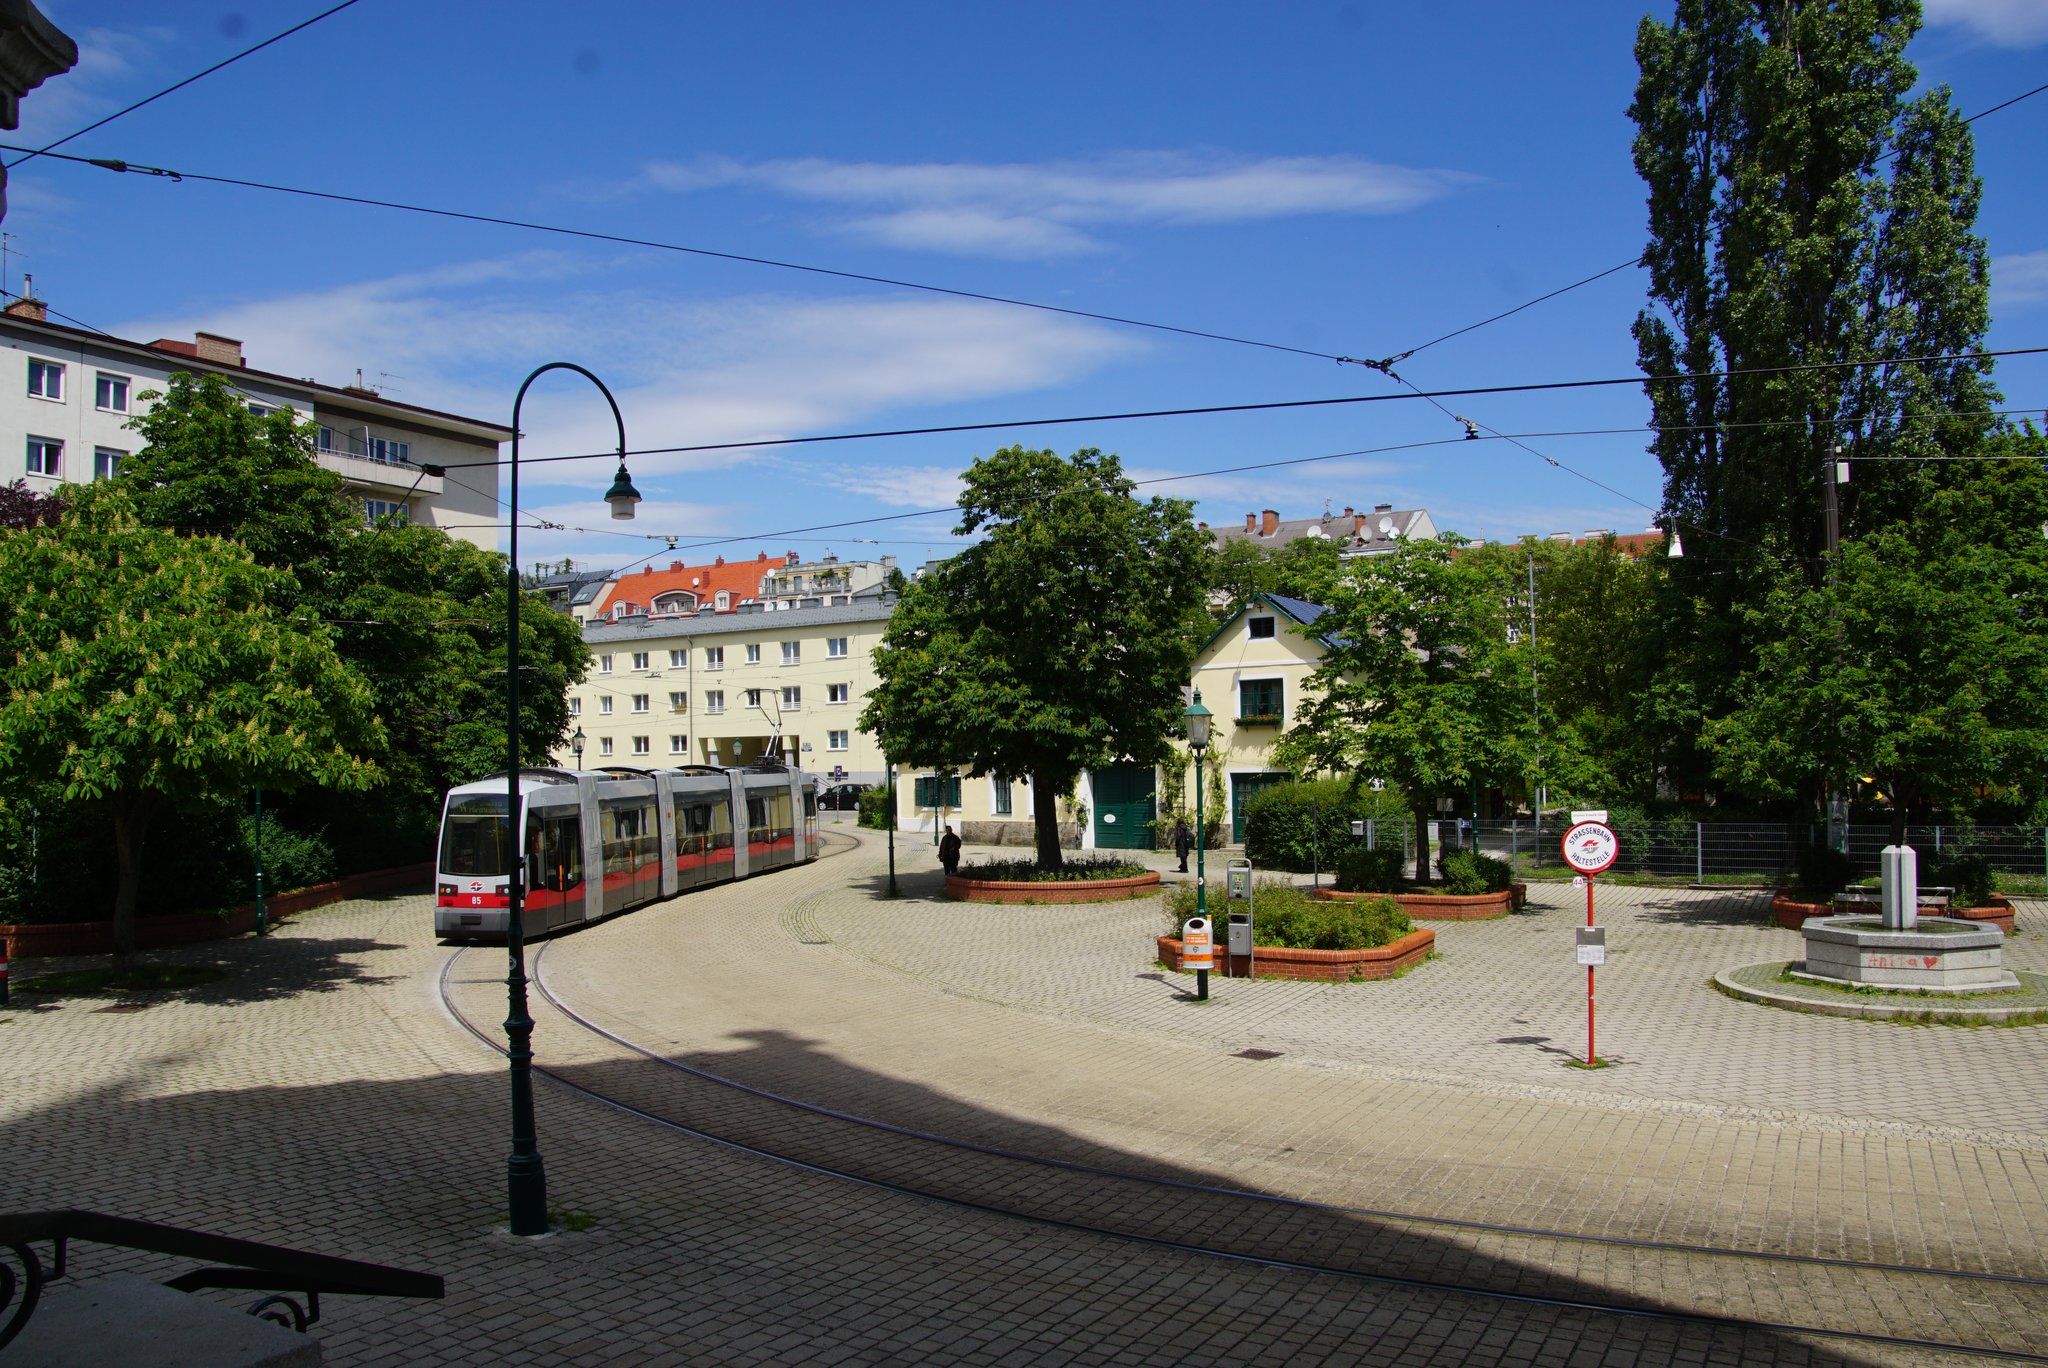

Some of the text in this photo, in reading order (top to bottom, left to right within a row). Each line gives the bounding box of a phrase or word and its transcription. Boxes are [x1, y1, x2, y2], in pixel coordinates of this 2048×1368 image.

[1569, 827, 1611, 845] STRASSENBAHN
[1571, 851, 1610, 866] HALTESTELLE
[471, 896, 482, 905] 85
[1868, 950, 1918, 968] Anita
